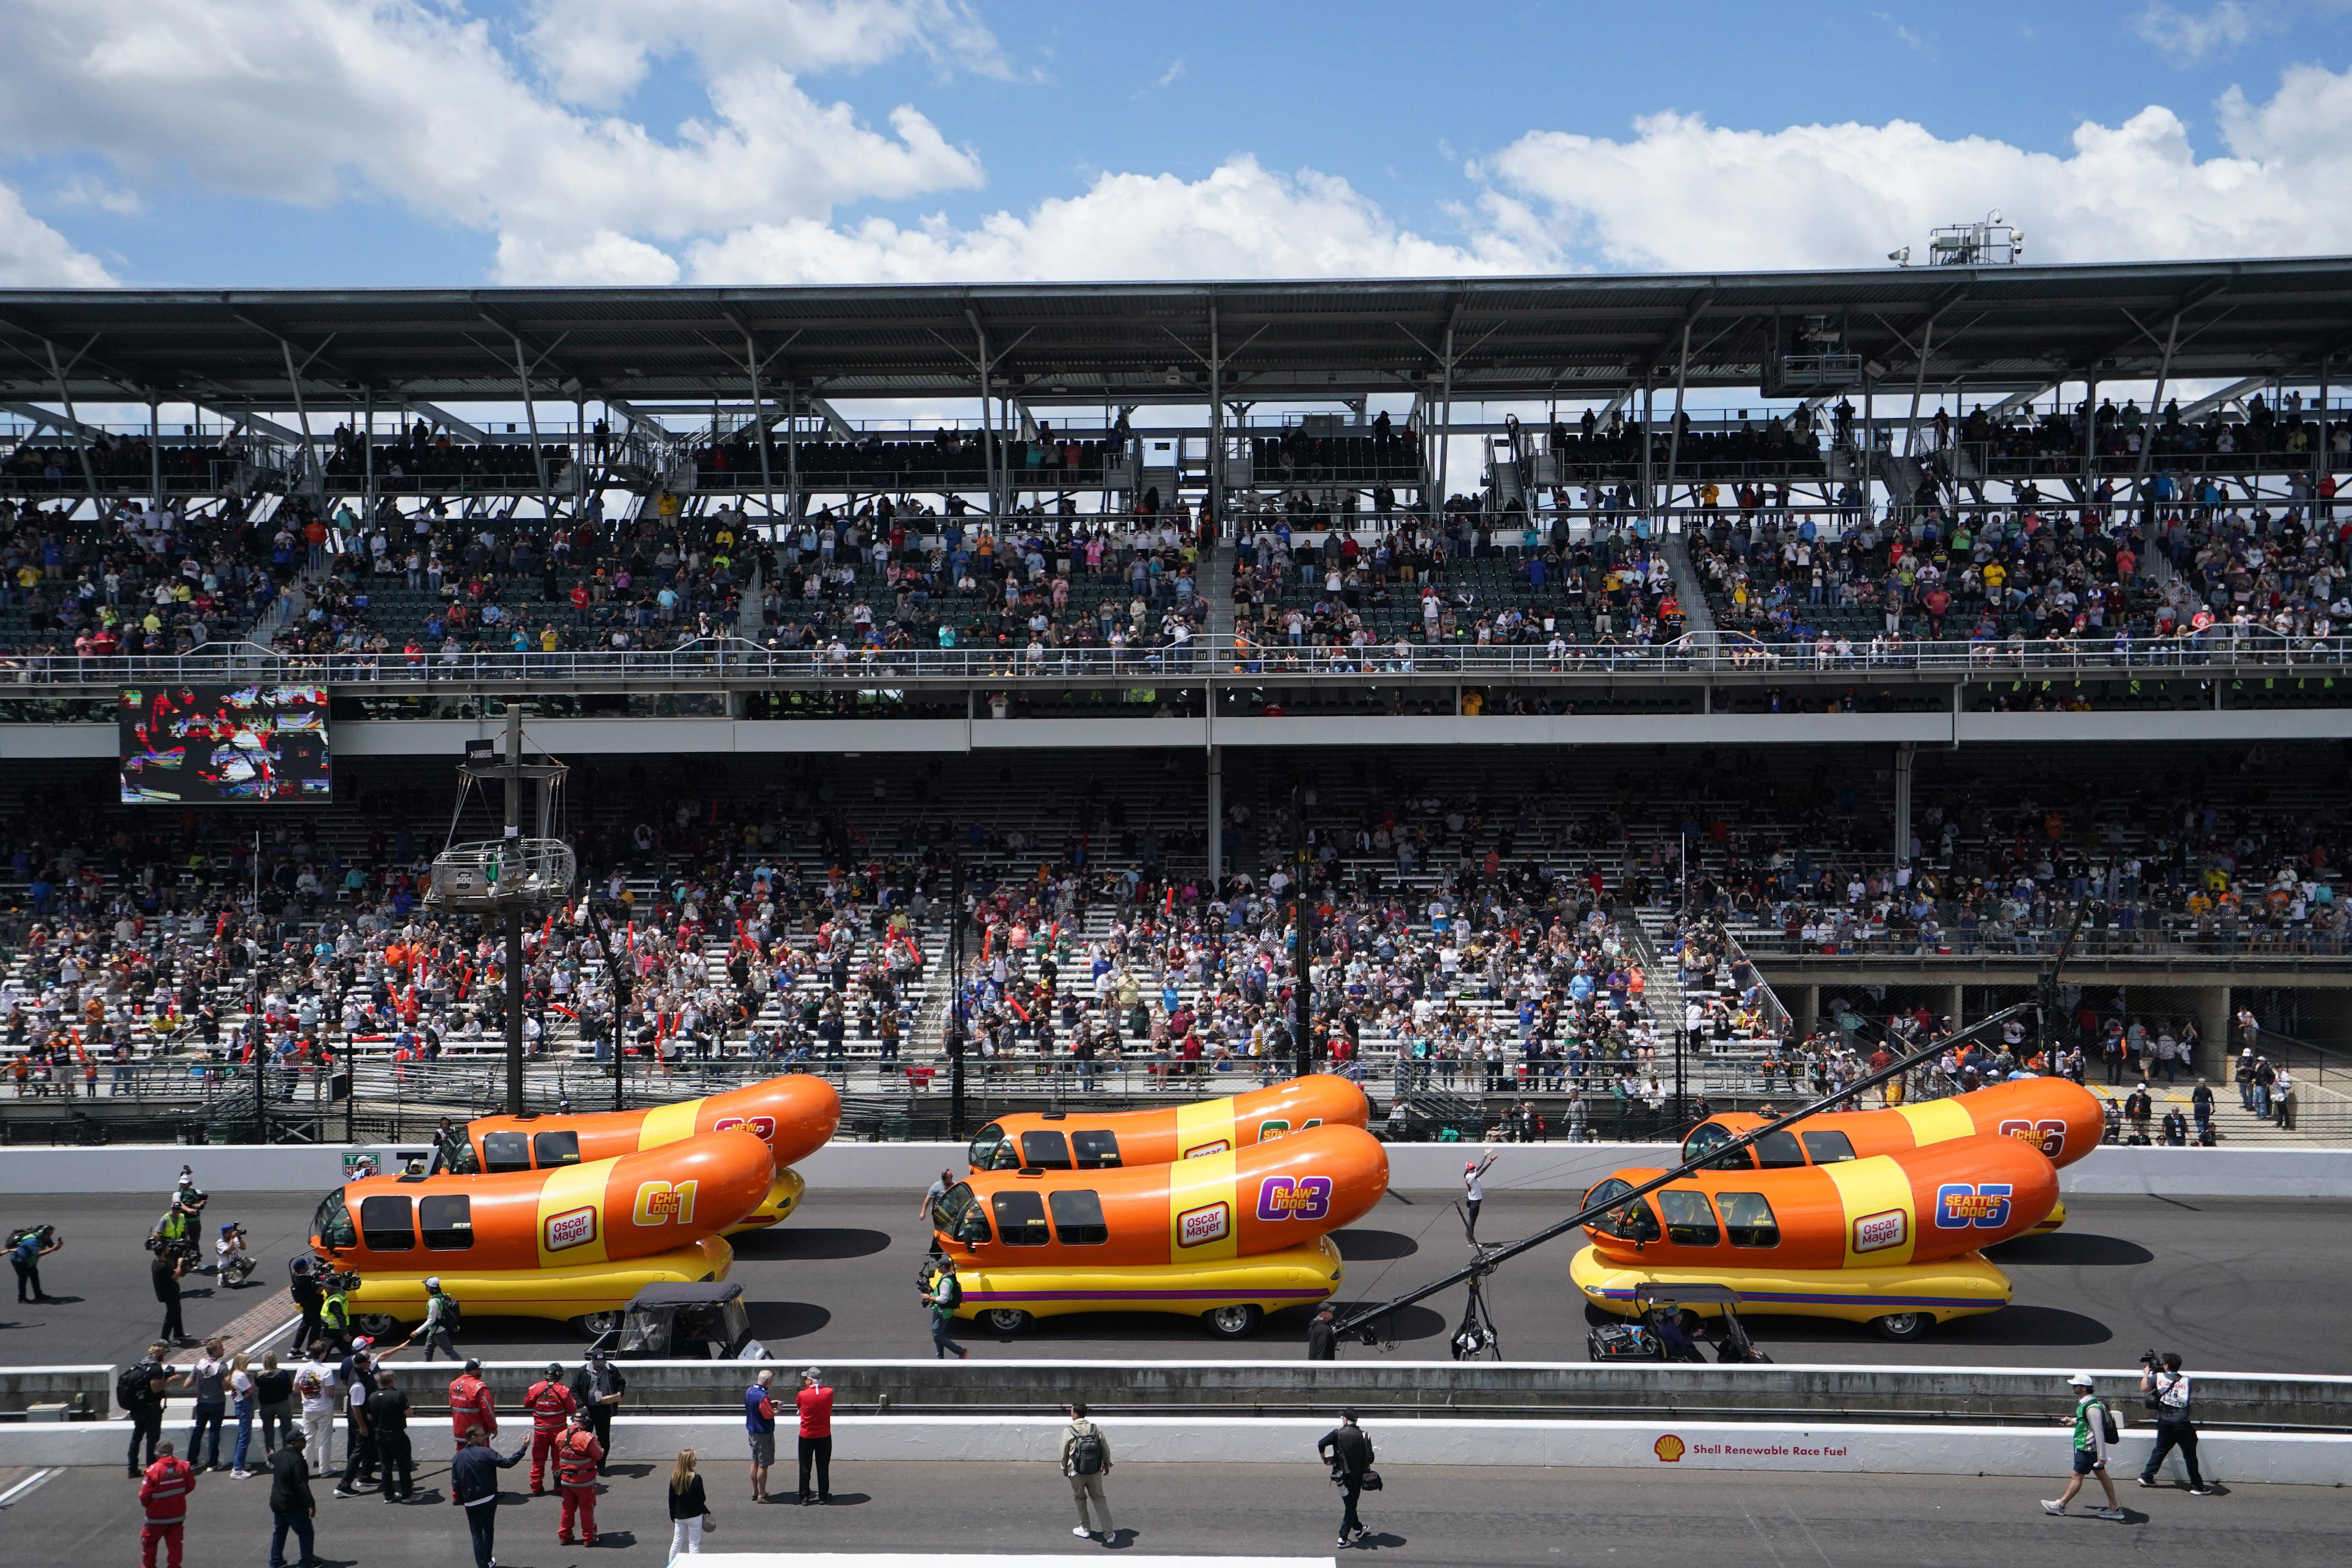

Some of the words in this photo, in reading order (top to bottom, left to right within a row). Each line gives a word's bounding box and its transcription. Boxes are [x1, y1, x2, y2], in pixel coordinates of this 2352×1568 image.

[732, 1123, 757, 1132] NEW
[2016, 1130, 2047, 1140] CHILI
[655, 1192, 677, 1203] CHI
[1257, 1176, 1333, 1221] 03
[1275, 1188, 1312, 1199] SLAW
[1280, 1199, 1308, 1210] DOG
[1934, 1183, 2013, 1229] 05
[1945, 1195, 2003, 1207] SEATTLE
[653, 1203, 678, 1214] DOG
[1959, 1206, 1987, 1217] DOG
[554, 1216, 587, 1232] Oscar
[1188, 1211, 1220, 1227] Oscar
[1186, 1222, 1220, 1238] Mayer
[1864, 1217, 1897, 1234] Oscar
[554, 1225, 588, 1243] Mayer
[1862, 1227, 1898, 1244] Mayer
[2159, 1381, 2186, 1390] Caon
[1694, 1444, 1721, 1454] Shell
[1725, 1446, 1788, 1455] Renewable
[1793, 1447, 1819, 1456] Race
[1824, 1447, 1846, 1456] Fuel
